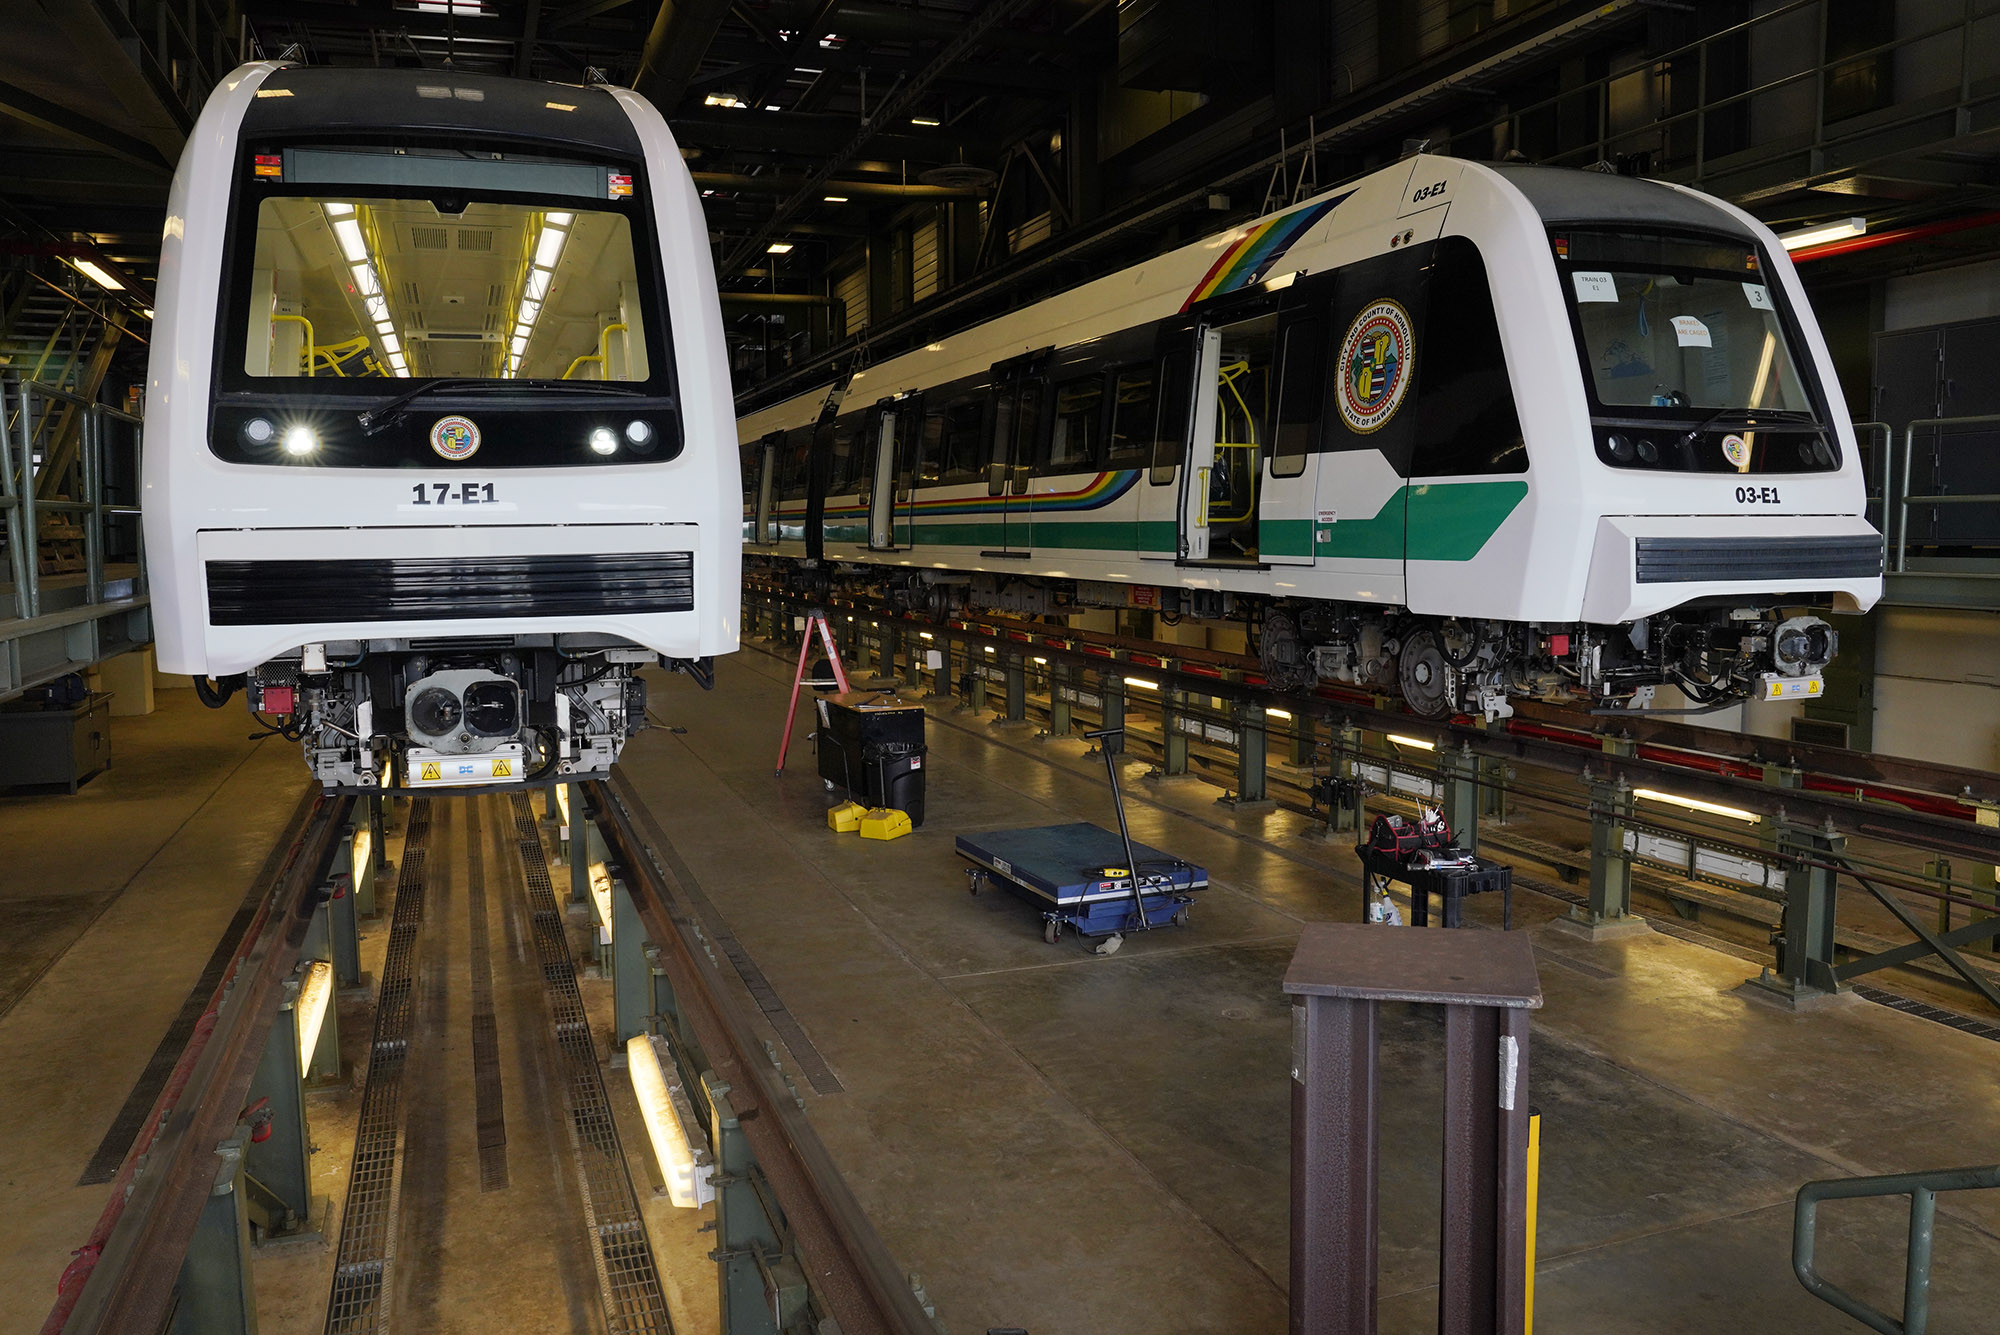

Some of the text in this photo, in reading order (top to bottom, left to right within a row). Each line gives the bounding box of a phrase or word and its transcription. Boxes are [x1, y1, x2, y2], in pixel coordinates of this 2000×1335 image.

[1413, 180, 1447, 203] 03-E1
[1754, 290, 1762, 302] 3
[1340, 306, 1410, 371] CITY AND COUNTY OF HONOLULU
[1344, 400, 1396, 426] STATE OF HAWAII
[412, 482, 499, 505] 17-E1
[1735, 486, 1781, 504] 03-E1
